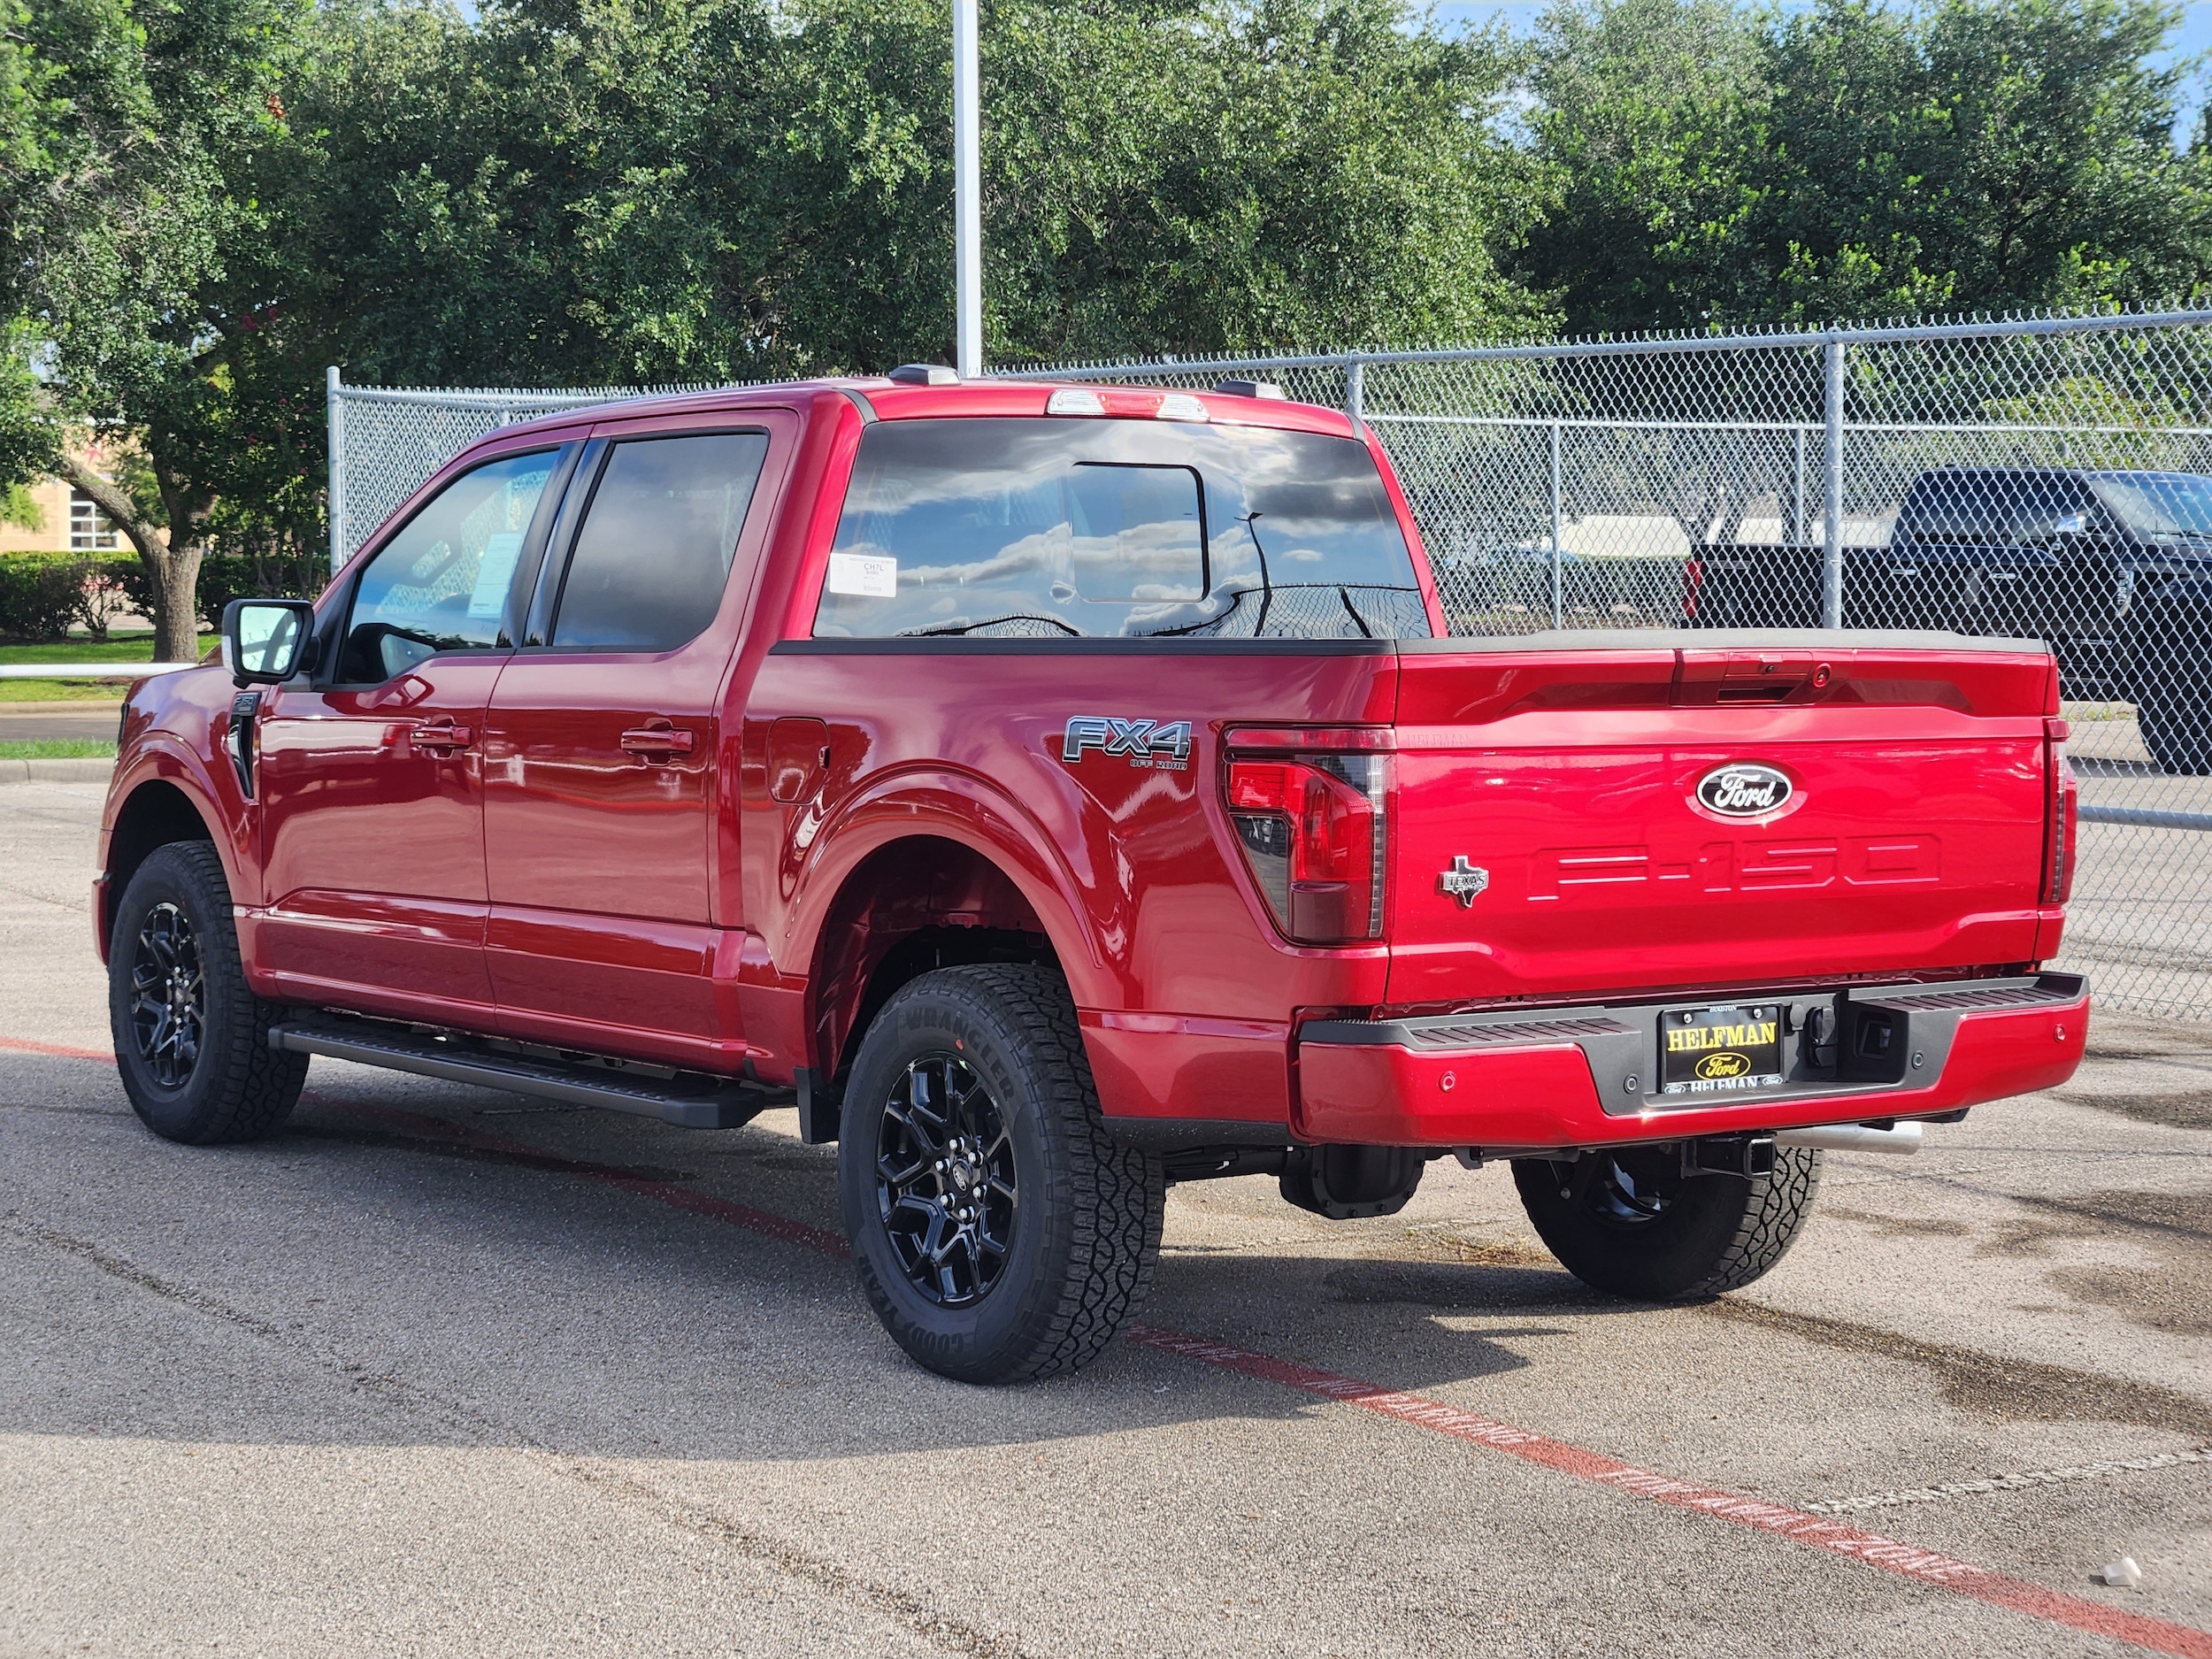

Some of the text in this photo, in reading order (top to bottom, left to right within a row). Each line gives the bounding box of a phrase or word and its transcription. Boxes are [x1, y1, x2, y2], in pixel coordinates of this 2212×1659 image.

[1062, 715, 1192, 764] FX4
[1130, 758, 1187, 771] OFF ROAD
[1714, 772, 1775, 808] Ford
[1448, 874, 1486, 887] TEXAS
[1526, 832, 1942, 902] F-150
[1709, 1004, 1738, 1014] HOUSTON
[1667, 1022, 1777, 1052] HELFMAN
[904, 1007, 1016, 1102] WRANGLER
[1705, 1056, 1740, 1077] Ford
